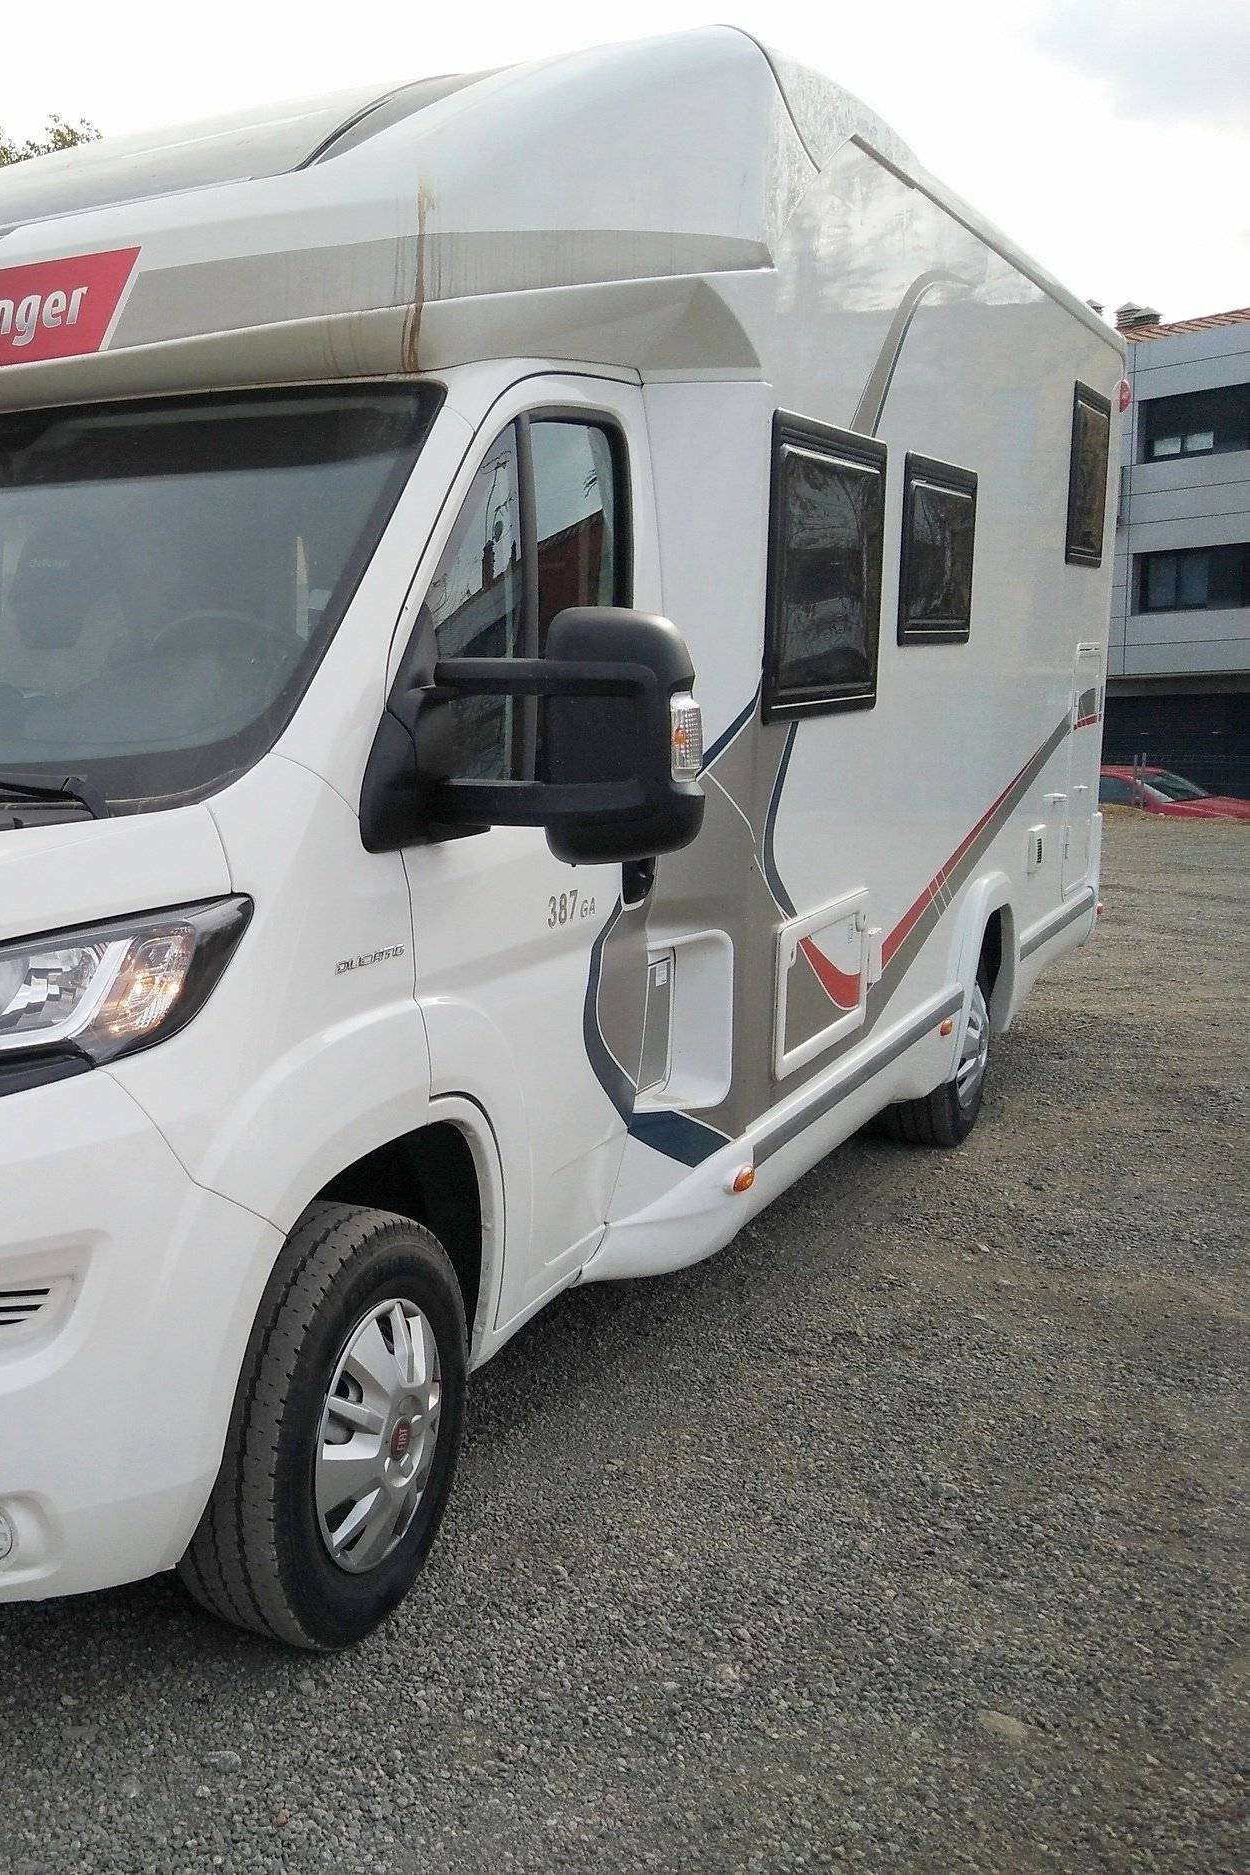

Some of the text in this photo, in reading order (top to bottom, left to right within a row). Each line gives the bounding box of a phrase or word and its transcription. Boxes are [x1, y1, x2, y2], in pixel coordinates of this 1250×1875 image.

[547, 889, 596, 929] 387 GA
[396, 1428, 408, 1451] FIAT
